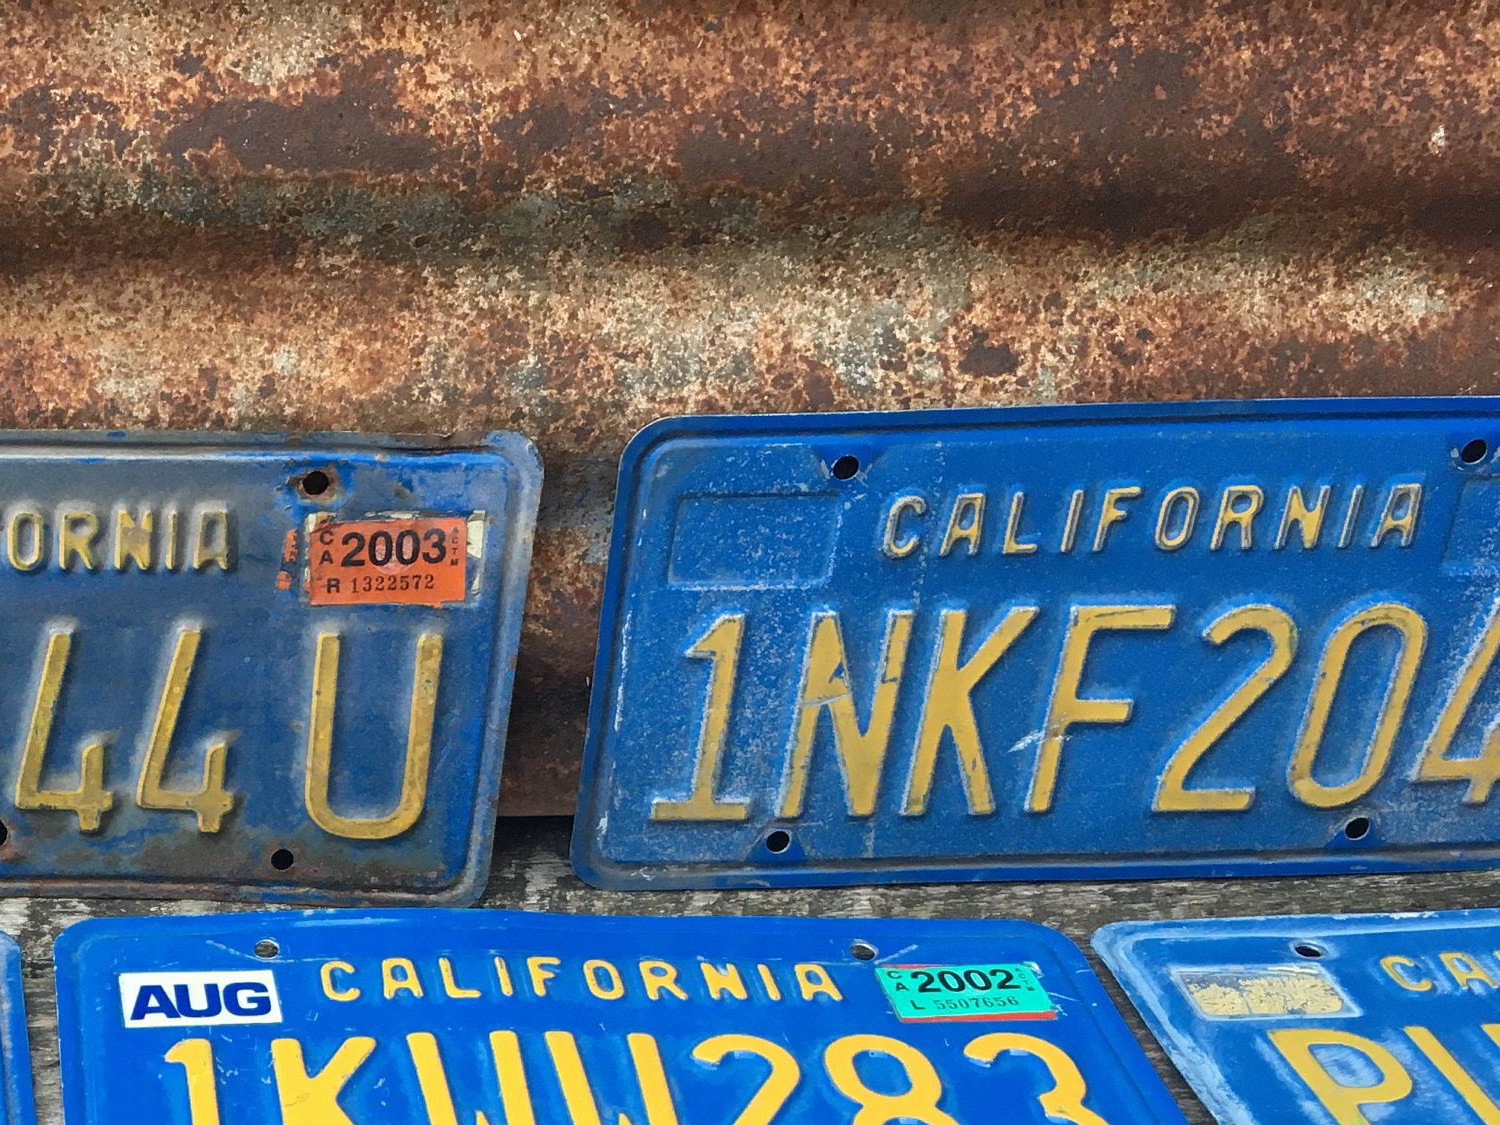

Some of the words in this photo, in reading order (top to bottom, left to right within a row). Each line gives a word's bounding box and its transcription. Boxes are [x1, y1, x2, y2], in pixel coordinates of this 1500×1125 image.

[882, 482, 1423, 559] CALIFORNIA
[341, 528, 447, 567] 2003
[326, 577, 341, 594] R
[351, 573, 435, 594] 1322572
[650, 600, 1500, 820] 1NKF204
[305, 630, 443, 841] U
[130, 982, 272, 1020] AUG
[319, 956, 845, 1004] CALIFORNIA
[910, 969, 1021, 993] 2002
